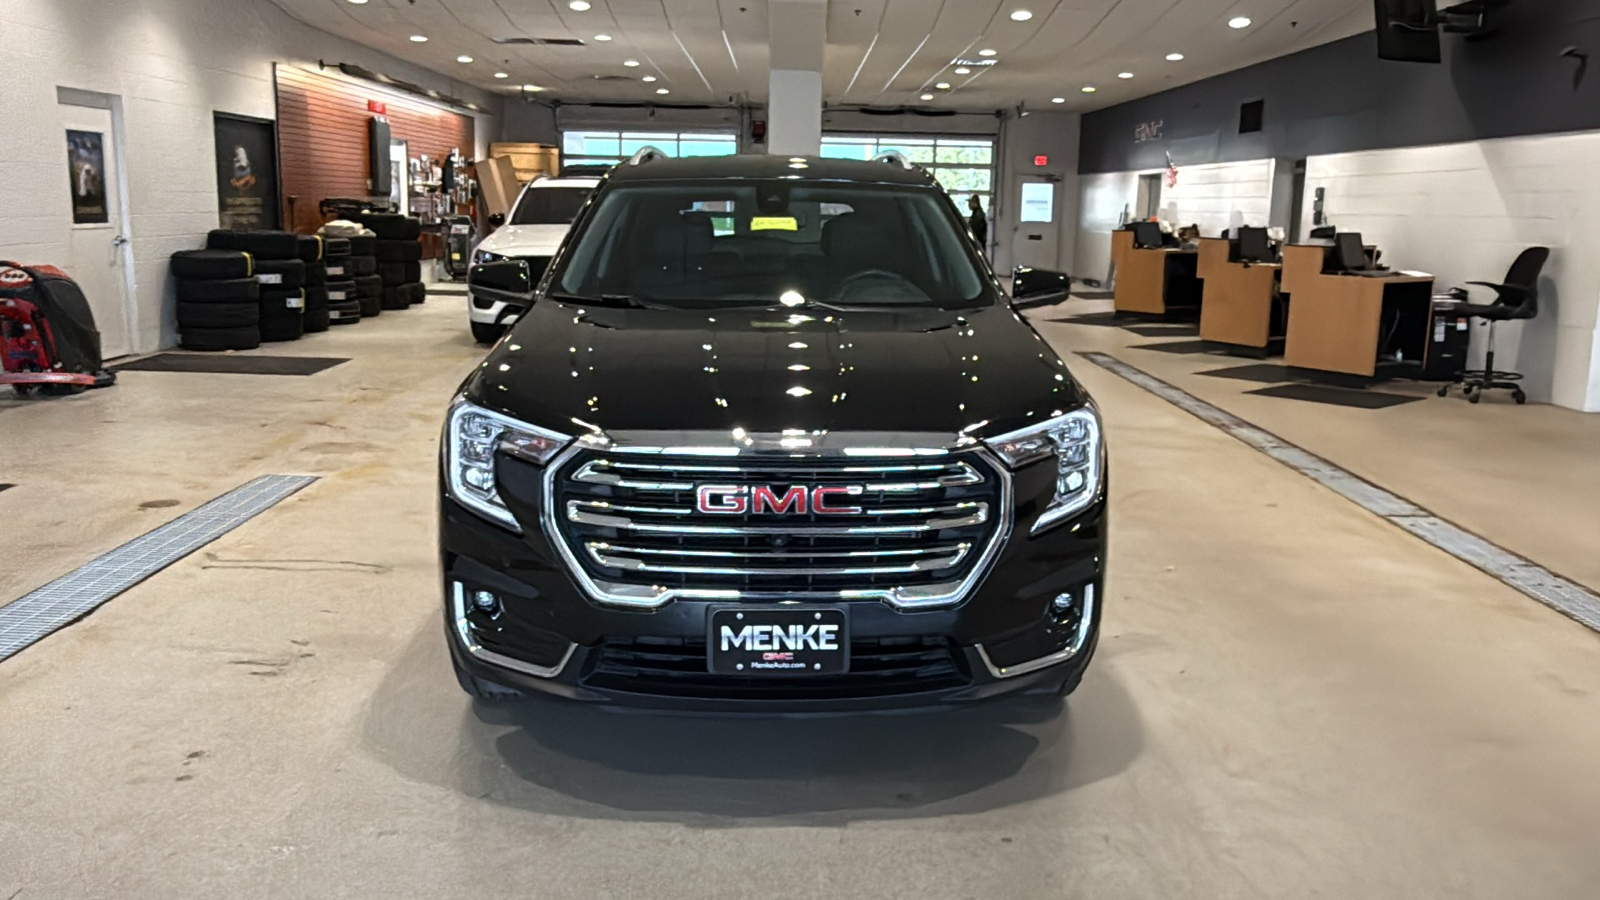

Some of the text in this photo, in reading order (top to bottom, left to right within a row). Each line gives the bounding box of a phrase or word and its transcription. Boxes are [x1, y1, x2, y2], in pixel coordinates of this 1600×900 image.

[697, 485, 863, 514] GMC
[720, 624, 839, 651] MENKE
[750, 661, 806, 669] MenkeAuto.com
[762, 652, 794, 661] GMC
